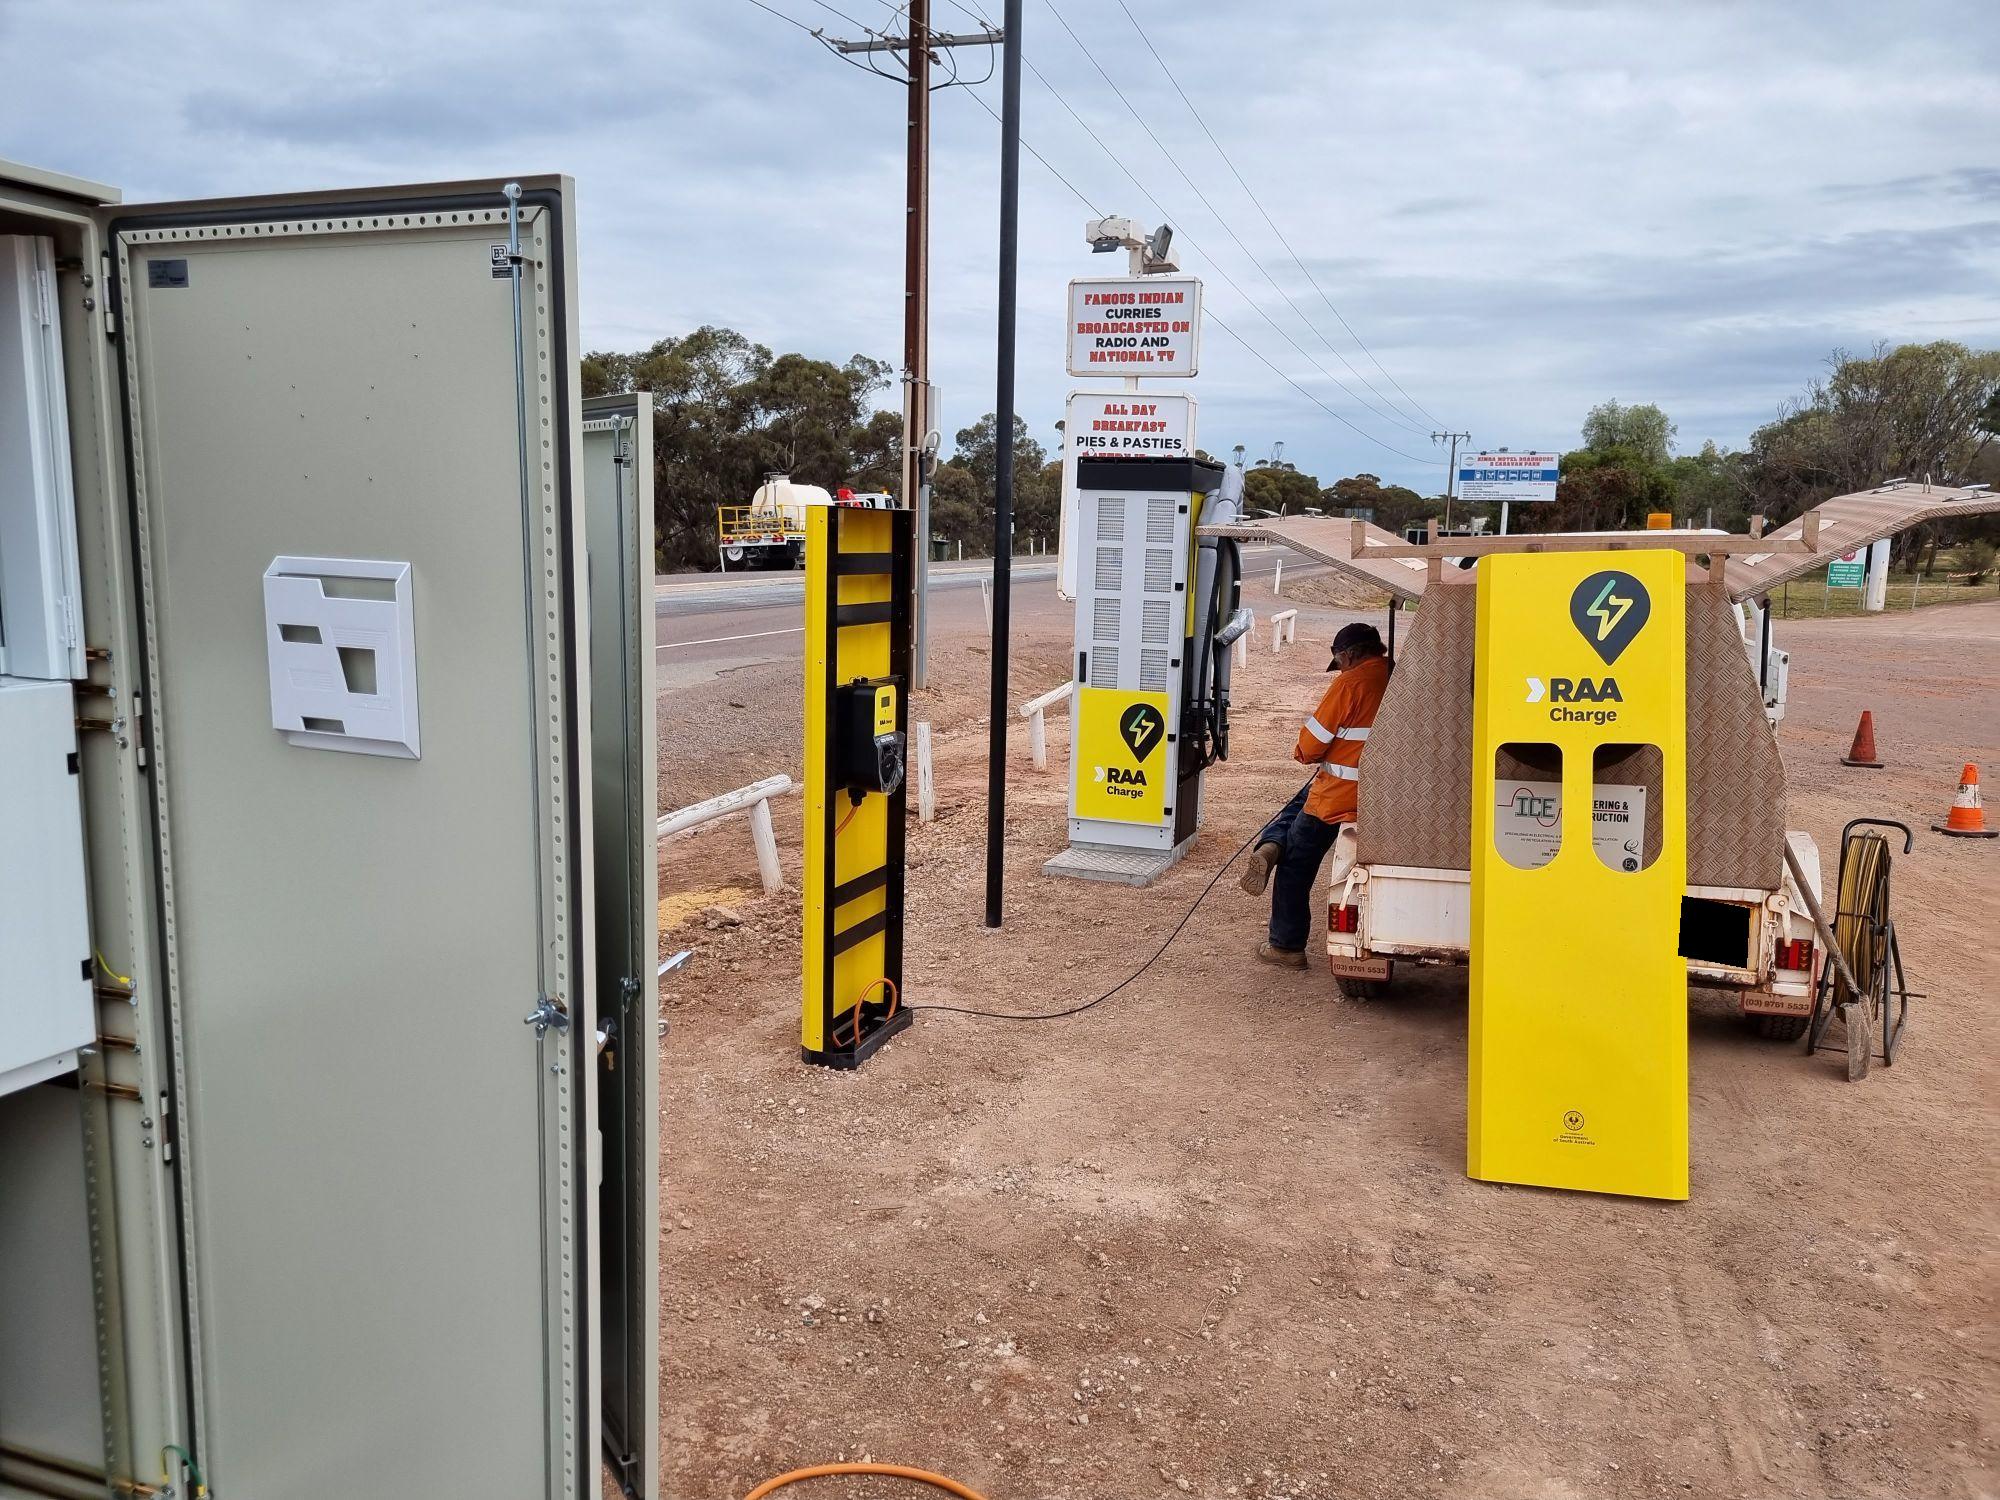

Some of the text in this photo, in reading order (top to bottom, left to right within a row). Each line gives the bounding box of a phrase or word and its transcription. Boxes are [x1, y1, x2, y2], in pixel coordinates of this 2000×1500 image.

[1084, 292, 1184, 305] FAMOUS INDIAN
[1106, 308, 1162, 319] CURRIES
[1077, 321, 1190, 334] BROADCASTED ON
[1096, 337, 1170, 348] RADIO AND
[1090, 350, 1176, 362] NATIONAL TV
[1104, 404, 1157, 416] ALL DAY
[1092, 420, 1167, 432] BREAKFAST
[1076, 436, 1182, 450] PIES & PASTIES
[1550, 678, 1624, 702] RAA
[1550, 707, 1617, 726] Charge
[1108, 768, 1147, 786] RAA
[1107, 786, 1144, 799] Charge
[1515, 796, 1556, 819] ICE
[1593, 800, 1628, 810] ERING &
[1592, 813, 1629, 823] RUCTION
[1334, 964, 1347, 972] (03)
[1745, 999, 1762, 1007] (03)
